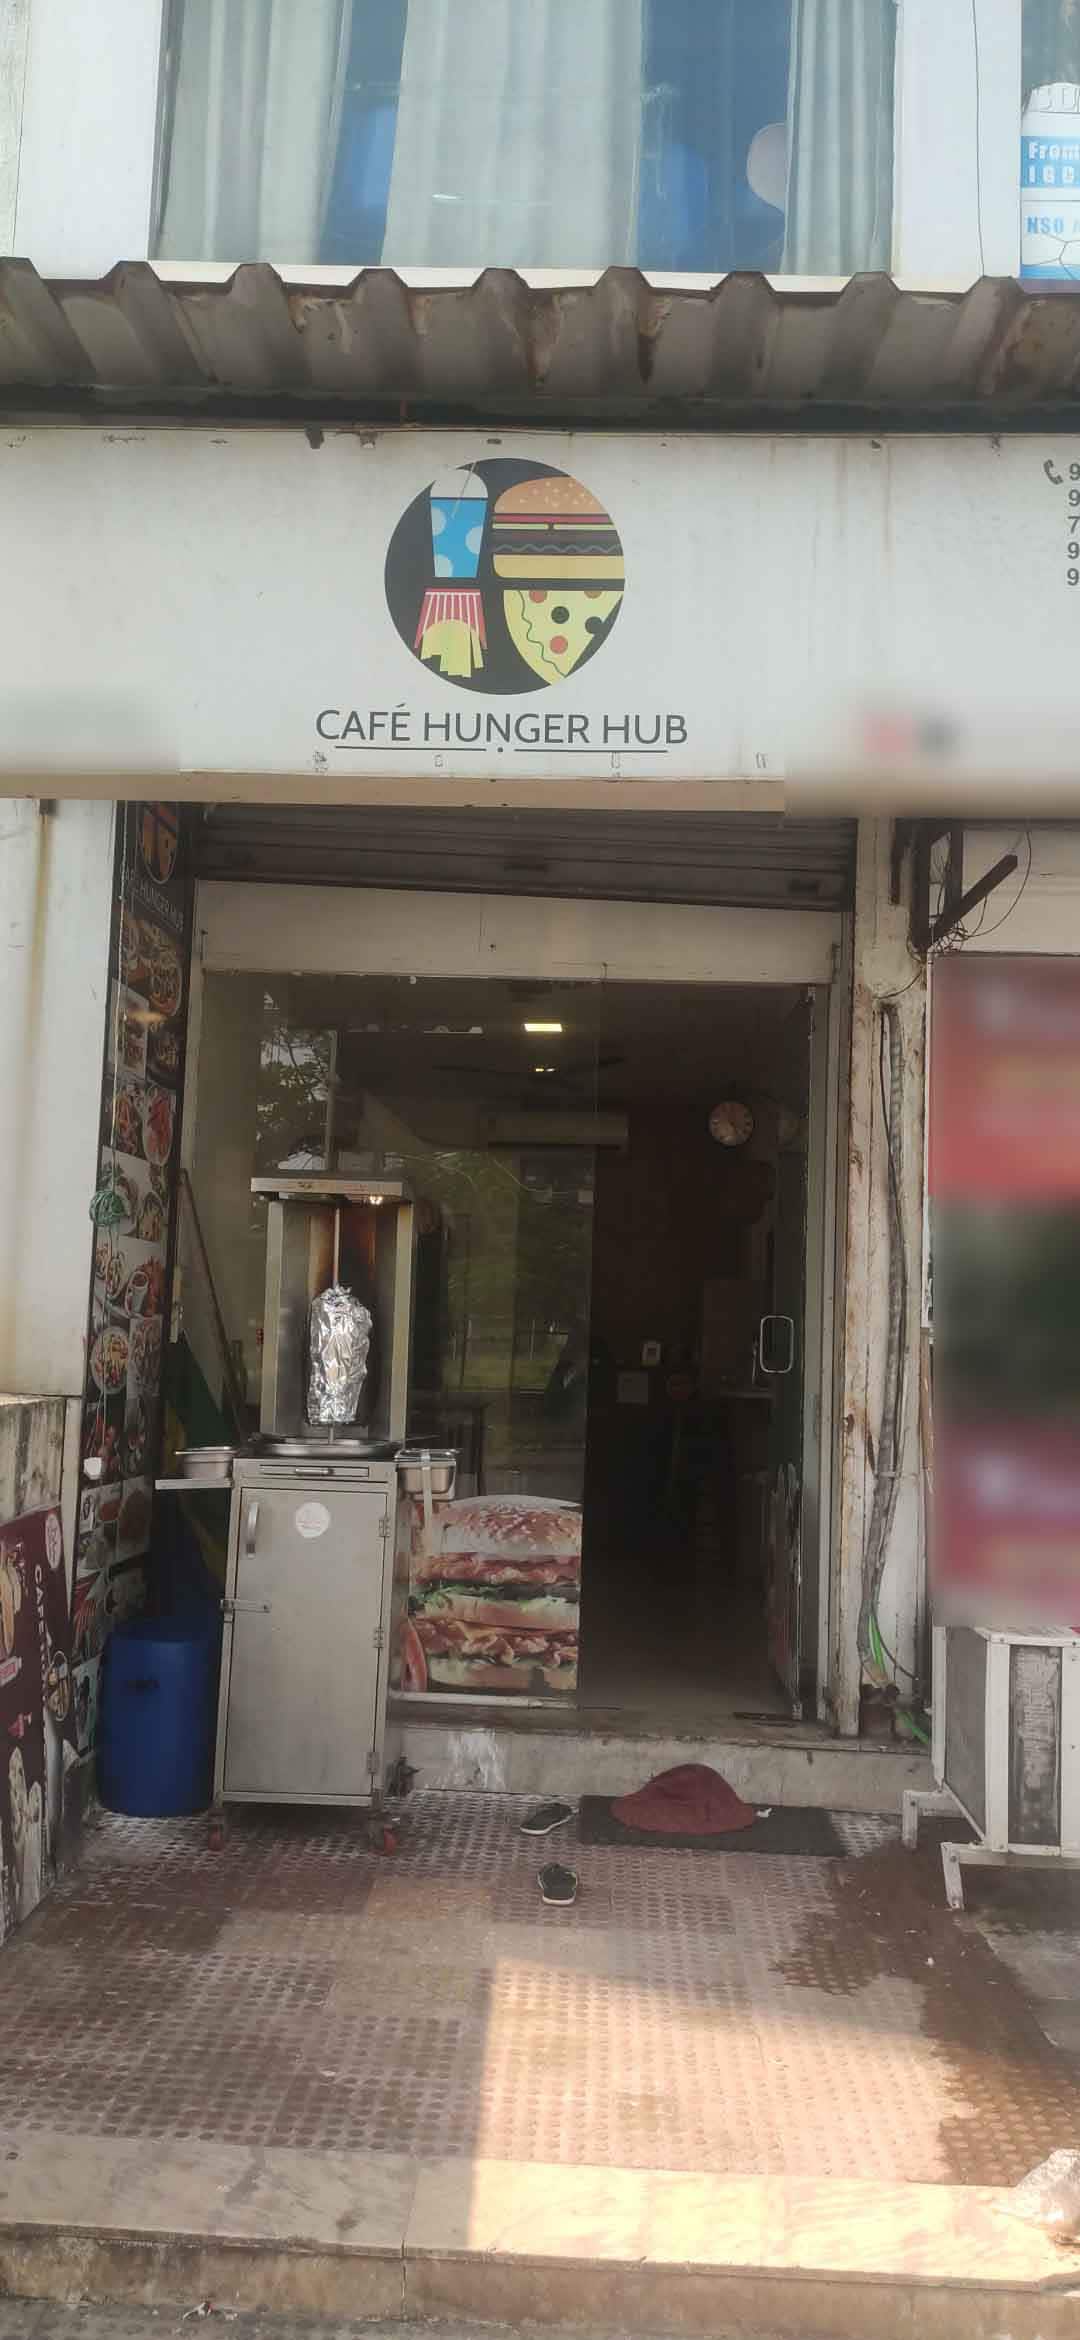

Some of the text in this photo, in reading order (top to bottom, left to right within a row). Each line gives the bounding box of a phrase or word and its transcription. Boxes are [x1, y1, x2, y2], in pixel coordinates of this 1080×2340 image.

[1027, 216, 1064, 234] NSO
[316, 703, 688, 745] CAFÉ HUNGER HUB
